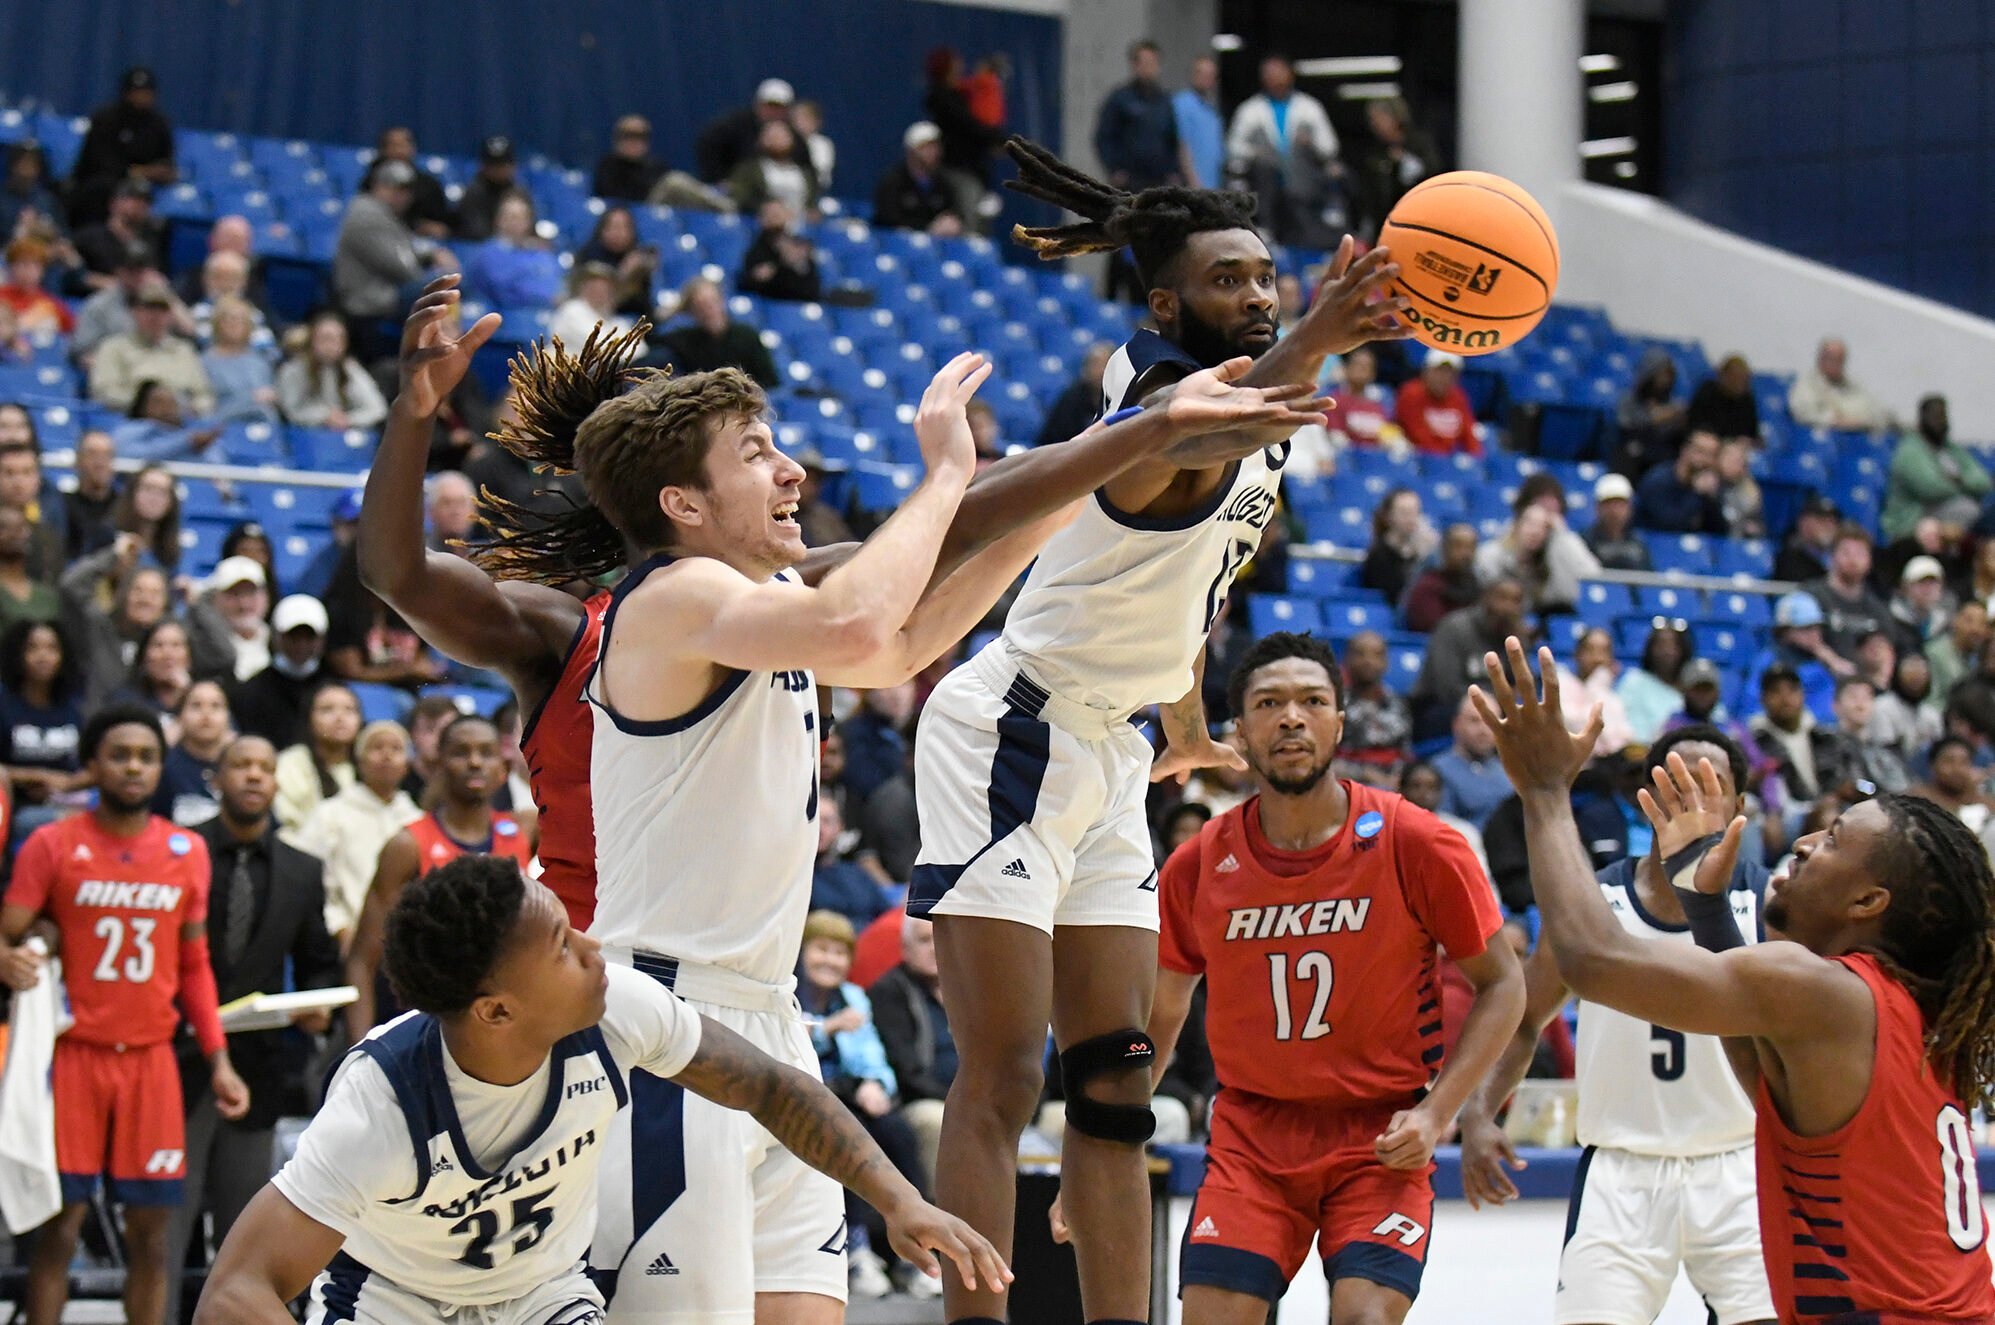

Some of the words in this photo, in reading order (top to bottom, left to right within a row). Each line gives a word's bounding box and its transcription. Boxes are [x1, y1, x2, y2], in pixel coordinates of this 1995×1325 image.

[1392, 292, 1500, 348] Wilso
[1001, 867, 1031, 880] adidas
[1225, 898, 1371, 941] AIKEN
[94, 916, 156, 983] 23
[1265, 950, 1334, 1041] 12
[566, 1076, 606, 1099] PBC
[1936, 1102, 1985, 1254] 0
[448, 1182, 561, 1270] 25
[645, 1266, 680, 1276] adidas
